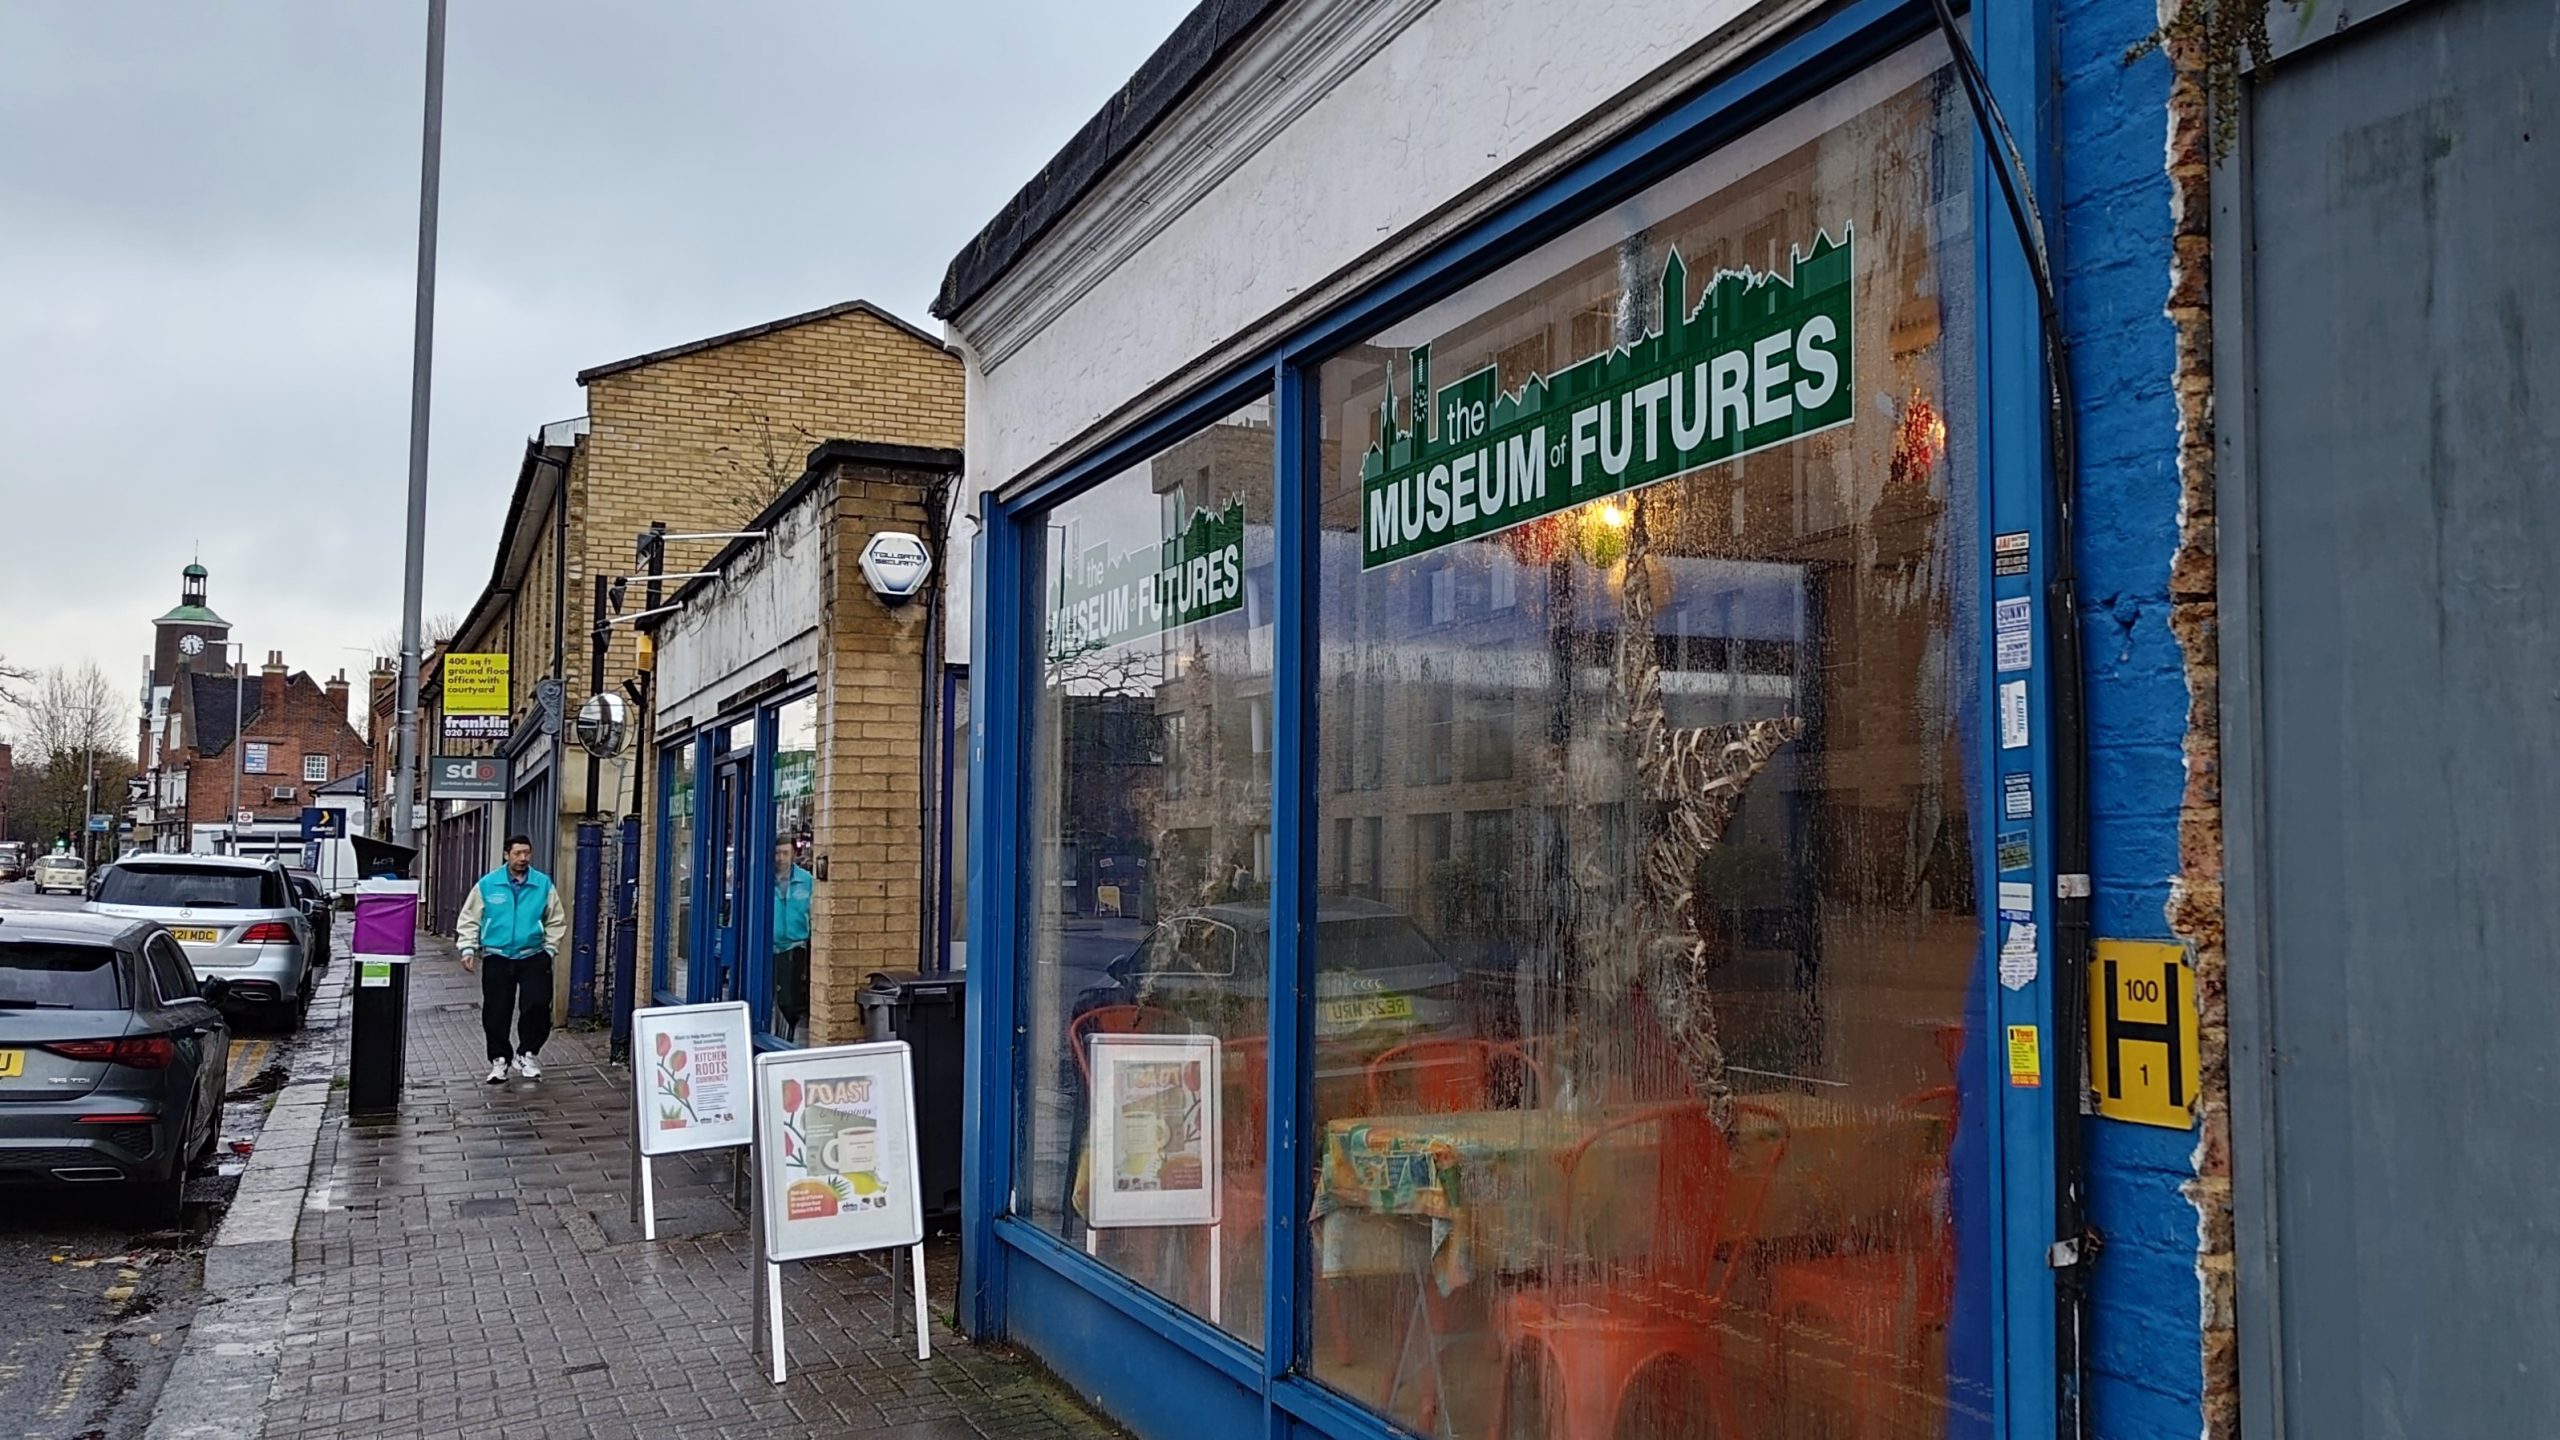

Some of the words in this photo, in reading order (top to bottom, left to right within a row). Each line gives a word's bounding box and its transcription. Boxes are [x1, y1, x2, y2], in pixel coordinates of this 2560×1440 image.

[1447, 398, 1485, 446] the
[1369, 426, 1546, 553] MUSEUM
[1550, 434, 1567, 469] of
[1571, 314, 1840, 488] FUTURES
[874, 552, 922, 560] TOLLGATE
[875, 559, 922, 567] SECURITY
[1086, 558, 1105, 589] the
[1138, 543, 1240, 627] FUTURES
[1998, 604, 2028, 621] SUNNY
[448, 657, 467, 665] 400
[470, 659, 481, 667] sq
[484, 657, 492, 666] ft
[448, 667, 483, 676] ground
[447, 676, 475, 684] office
[478, 676, 500, 684] with
[447, 685, 496, 695] courtyard
[445, 715, 509, 729] franklin
[445, 729, 463, 737] 020
[465, 729, 485, 737] 7117
[486, 729, 509, 737] 2526
[190, 930, 214, 940] MDC
[2124, 978, 2159, 1003] 100
[2103, 959, 2185, 1108] H
[694, 1050, 727, 1063] KITCHEN
[695, 1062, 728, 1075] ROOTS
[2139, 1063, 2149, 1086] 1
[805, 1080, 872, 1105] TOAST
